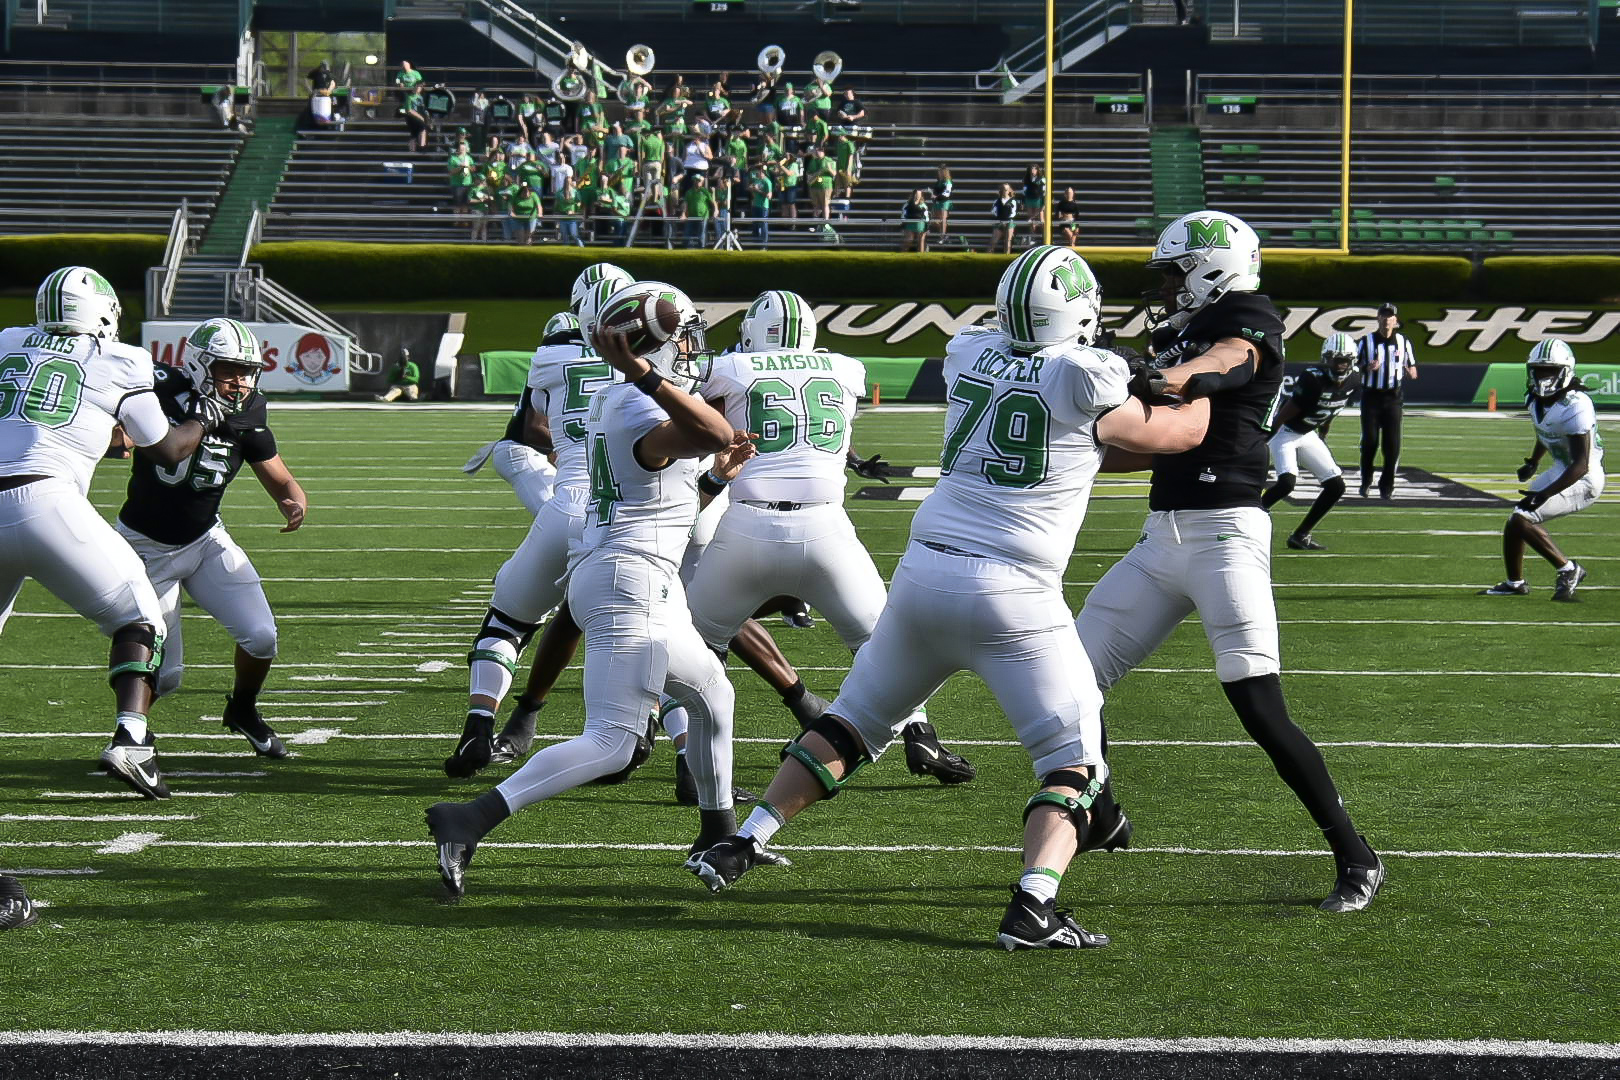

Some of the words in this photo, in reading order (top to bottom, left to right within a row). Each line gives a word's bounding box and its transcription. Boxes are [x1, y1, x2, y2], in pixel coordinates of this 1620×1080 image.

[1184, 218, 1231, 251] M
[1050, 257, 1094, 302] M
[22, 333, 79, 354] ADAMS
[752, 355, 833, 372] SAMSON
[745, 377, 847, 455] 66
[940, 373, 1051, 490] 79
